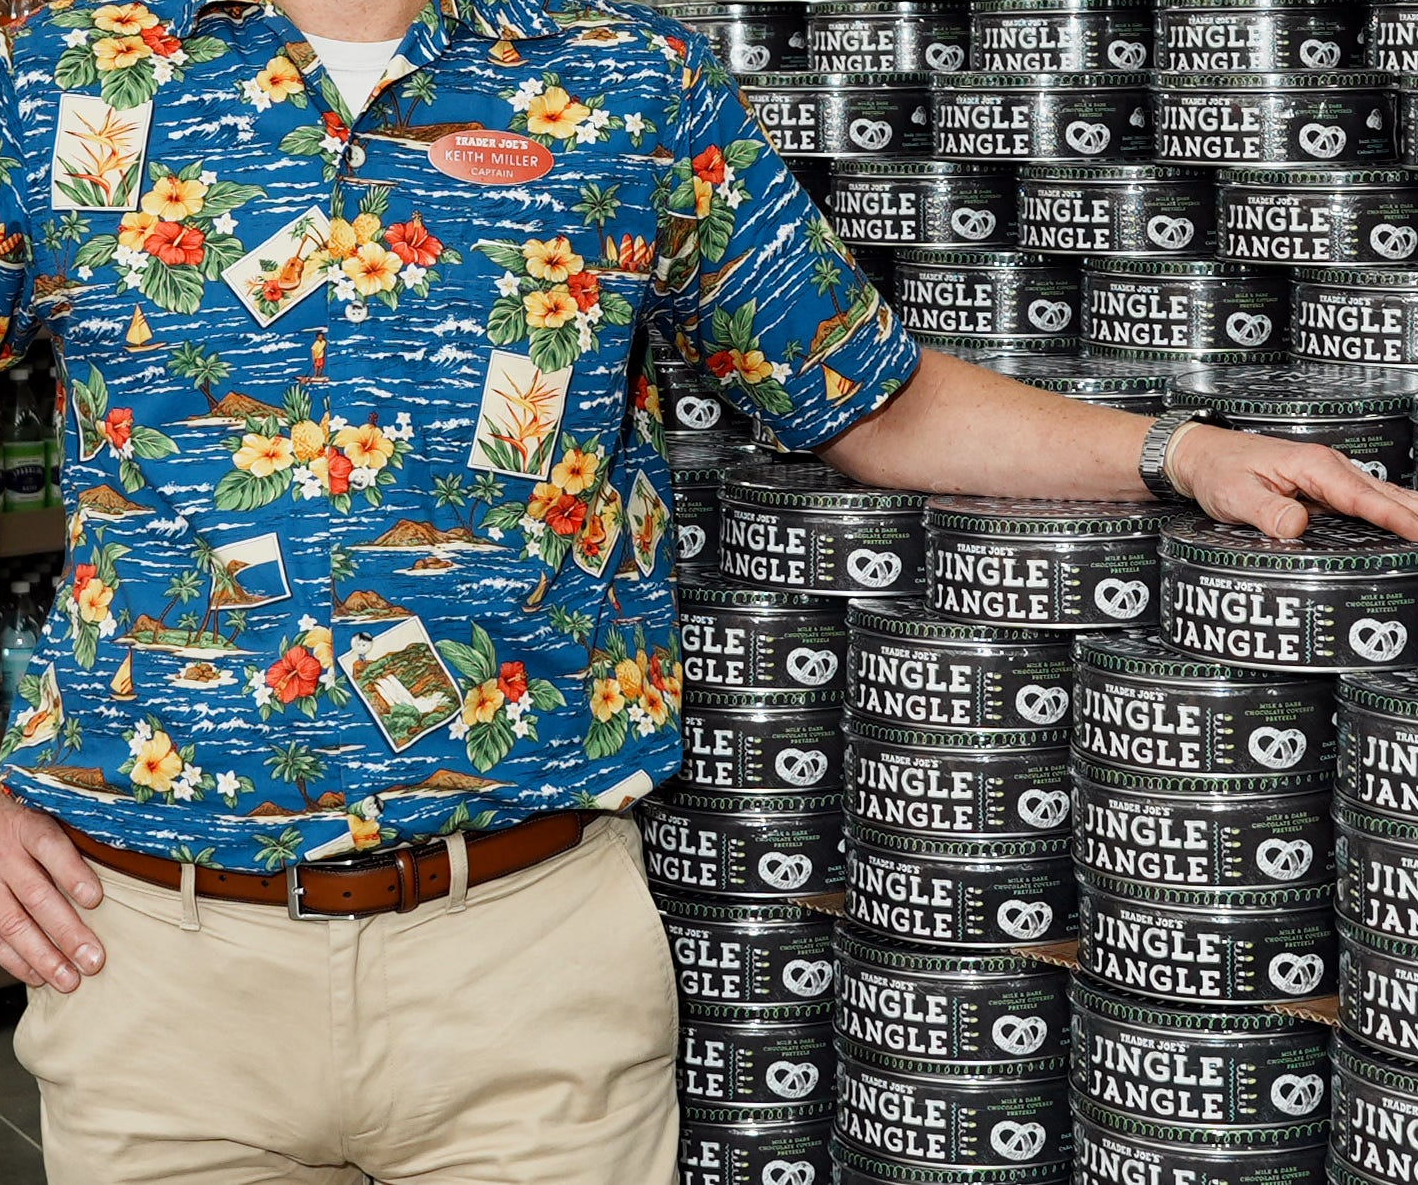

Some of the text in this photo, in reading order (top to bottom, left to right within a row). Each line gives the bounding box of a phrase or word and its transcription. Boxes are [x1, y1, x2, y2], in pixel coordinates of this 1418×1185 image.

[937, 103, 1030, 131] JINGLE
[455, 137, 529, 149] TRADER JOE'S
[936, 131, 1030, 157] JANGLE
[445, 150, 539, 167] KEITH MILLER
[471, 167, 514, 178] CAPTAIN
[1227, 203, 1331, 233] JINGLE
[1227, 233, 1331, 261] JANGLE
[934, 548, 1052, 589] JINGLE
[934, 583, 1050, 622] JANGLE
[1174, 581, 1301, 628] JINGLE
[1172, 620, 1301, 663] JANGLE
[857, 655, 973, 694] JINGLE
[856, 688, 972, 726] JANGLE
